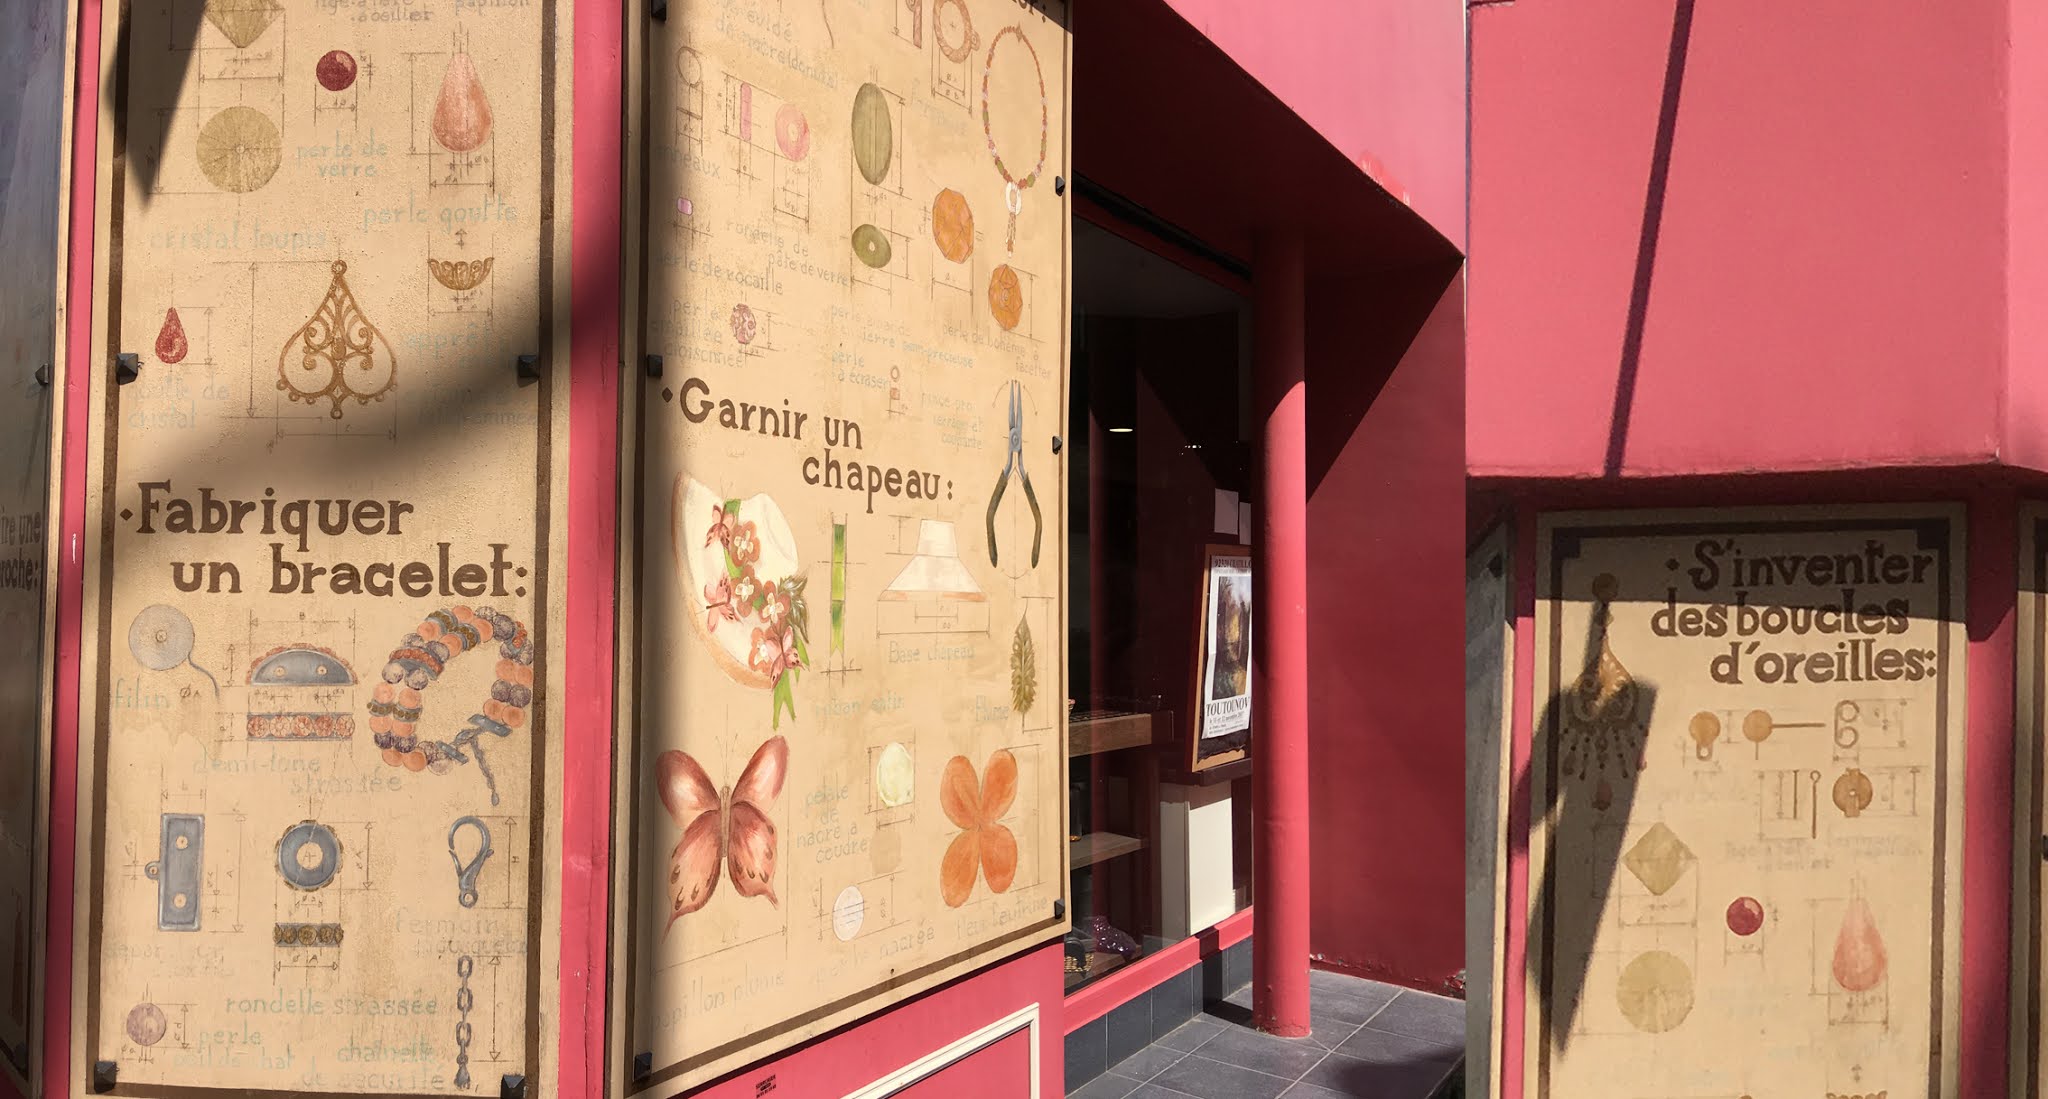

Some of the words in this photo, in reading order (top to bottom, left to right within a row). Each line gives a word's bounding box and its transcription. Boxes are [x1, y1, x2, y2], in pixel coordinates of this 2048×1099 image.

[679, 377, 808, 441] Garnir
[824, 416, 864, 451] un
[18, 511, 42, 545] une
[136, 480, 415, 553] Fabriquer
[170, 561, 243, 594] un
[269, 541, 529, 599] bracelet:
[1688, 538, 1934, 592] S'inventer
[1650, 587, 1729, 638] des
[1735, 590, 1911, 636] boucles
[1709, 640, 1938, 684] d'oreilles:
